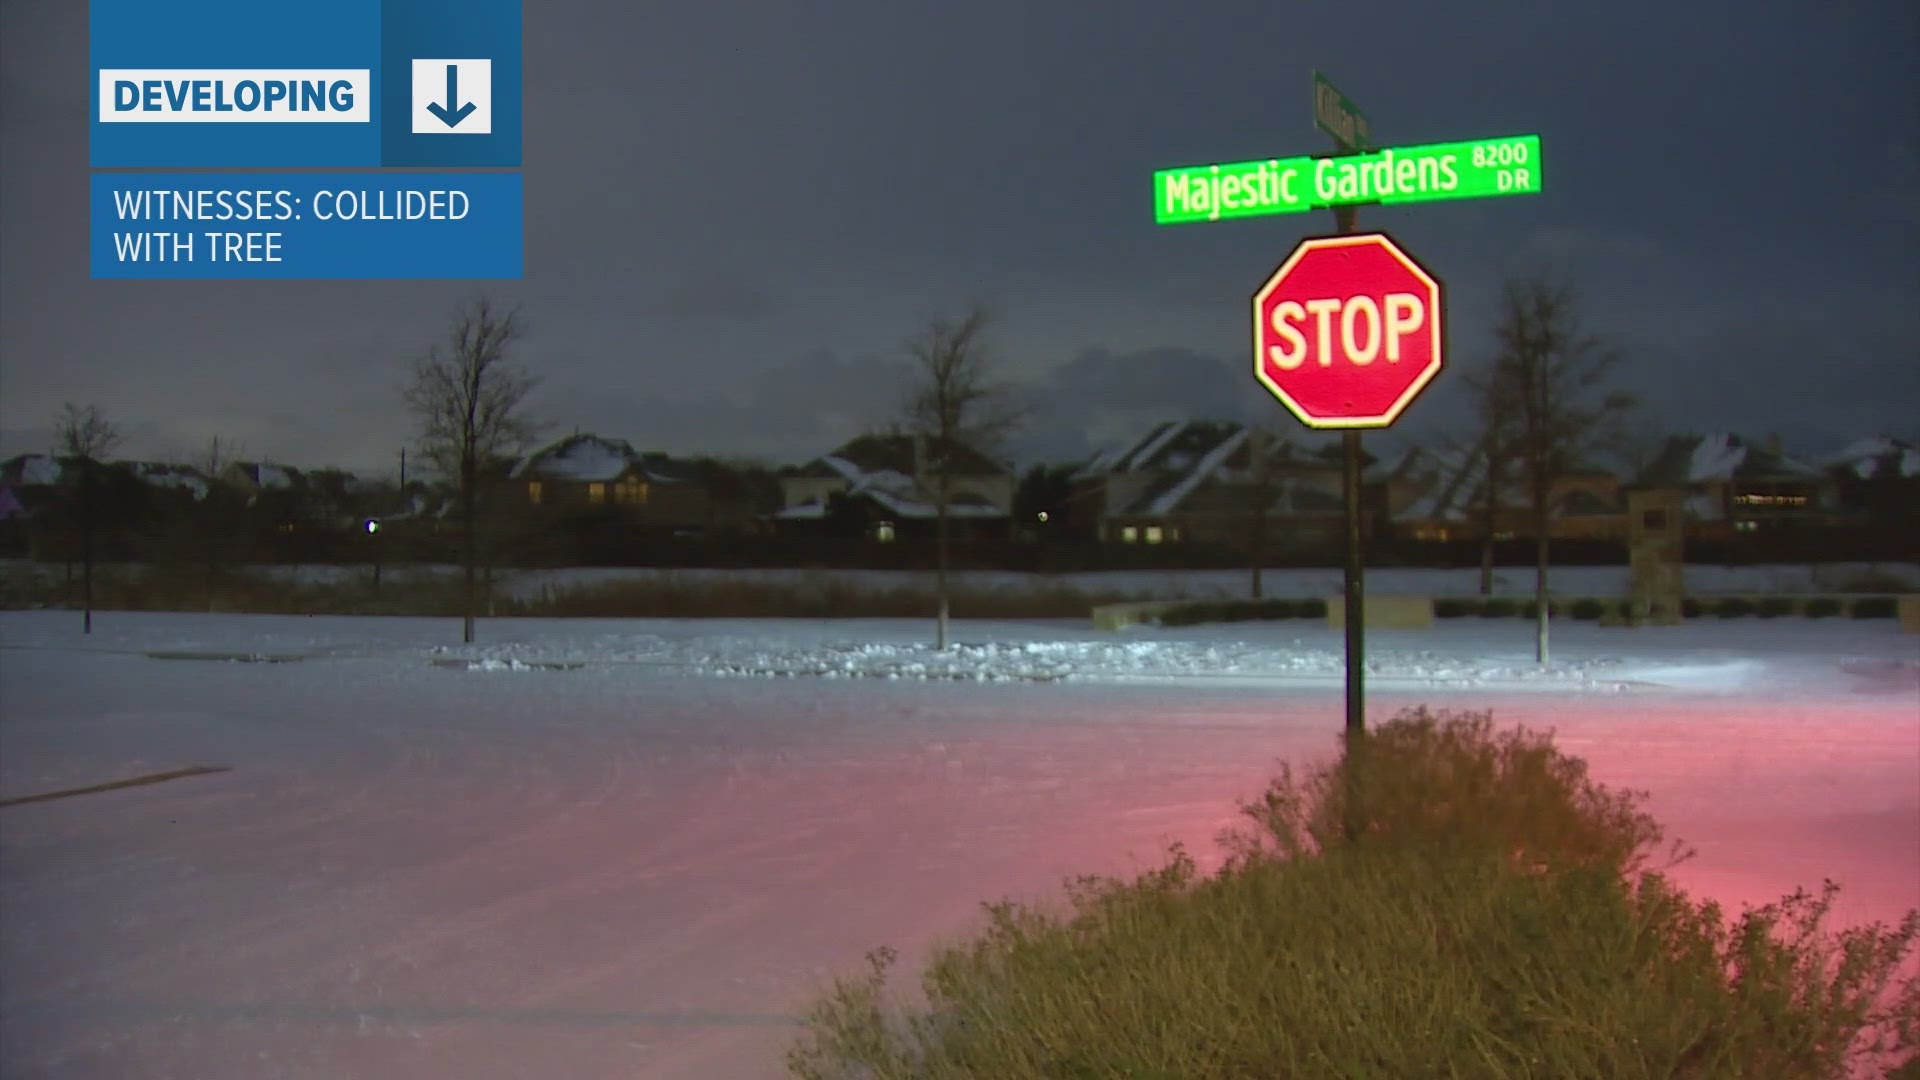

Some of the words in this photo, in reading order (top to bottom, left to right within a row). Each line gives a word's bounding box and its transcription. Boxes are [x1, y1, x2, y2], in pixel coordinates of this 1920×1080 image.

[1472, 142, 1528, 167] 8200
[1166, 160, 1298, 220] Majestic
[1315, 150, 1458, 201] Gardens
[1497, 168, 1530, 191] DR
[1269, 293, 1425, 370] STOP
